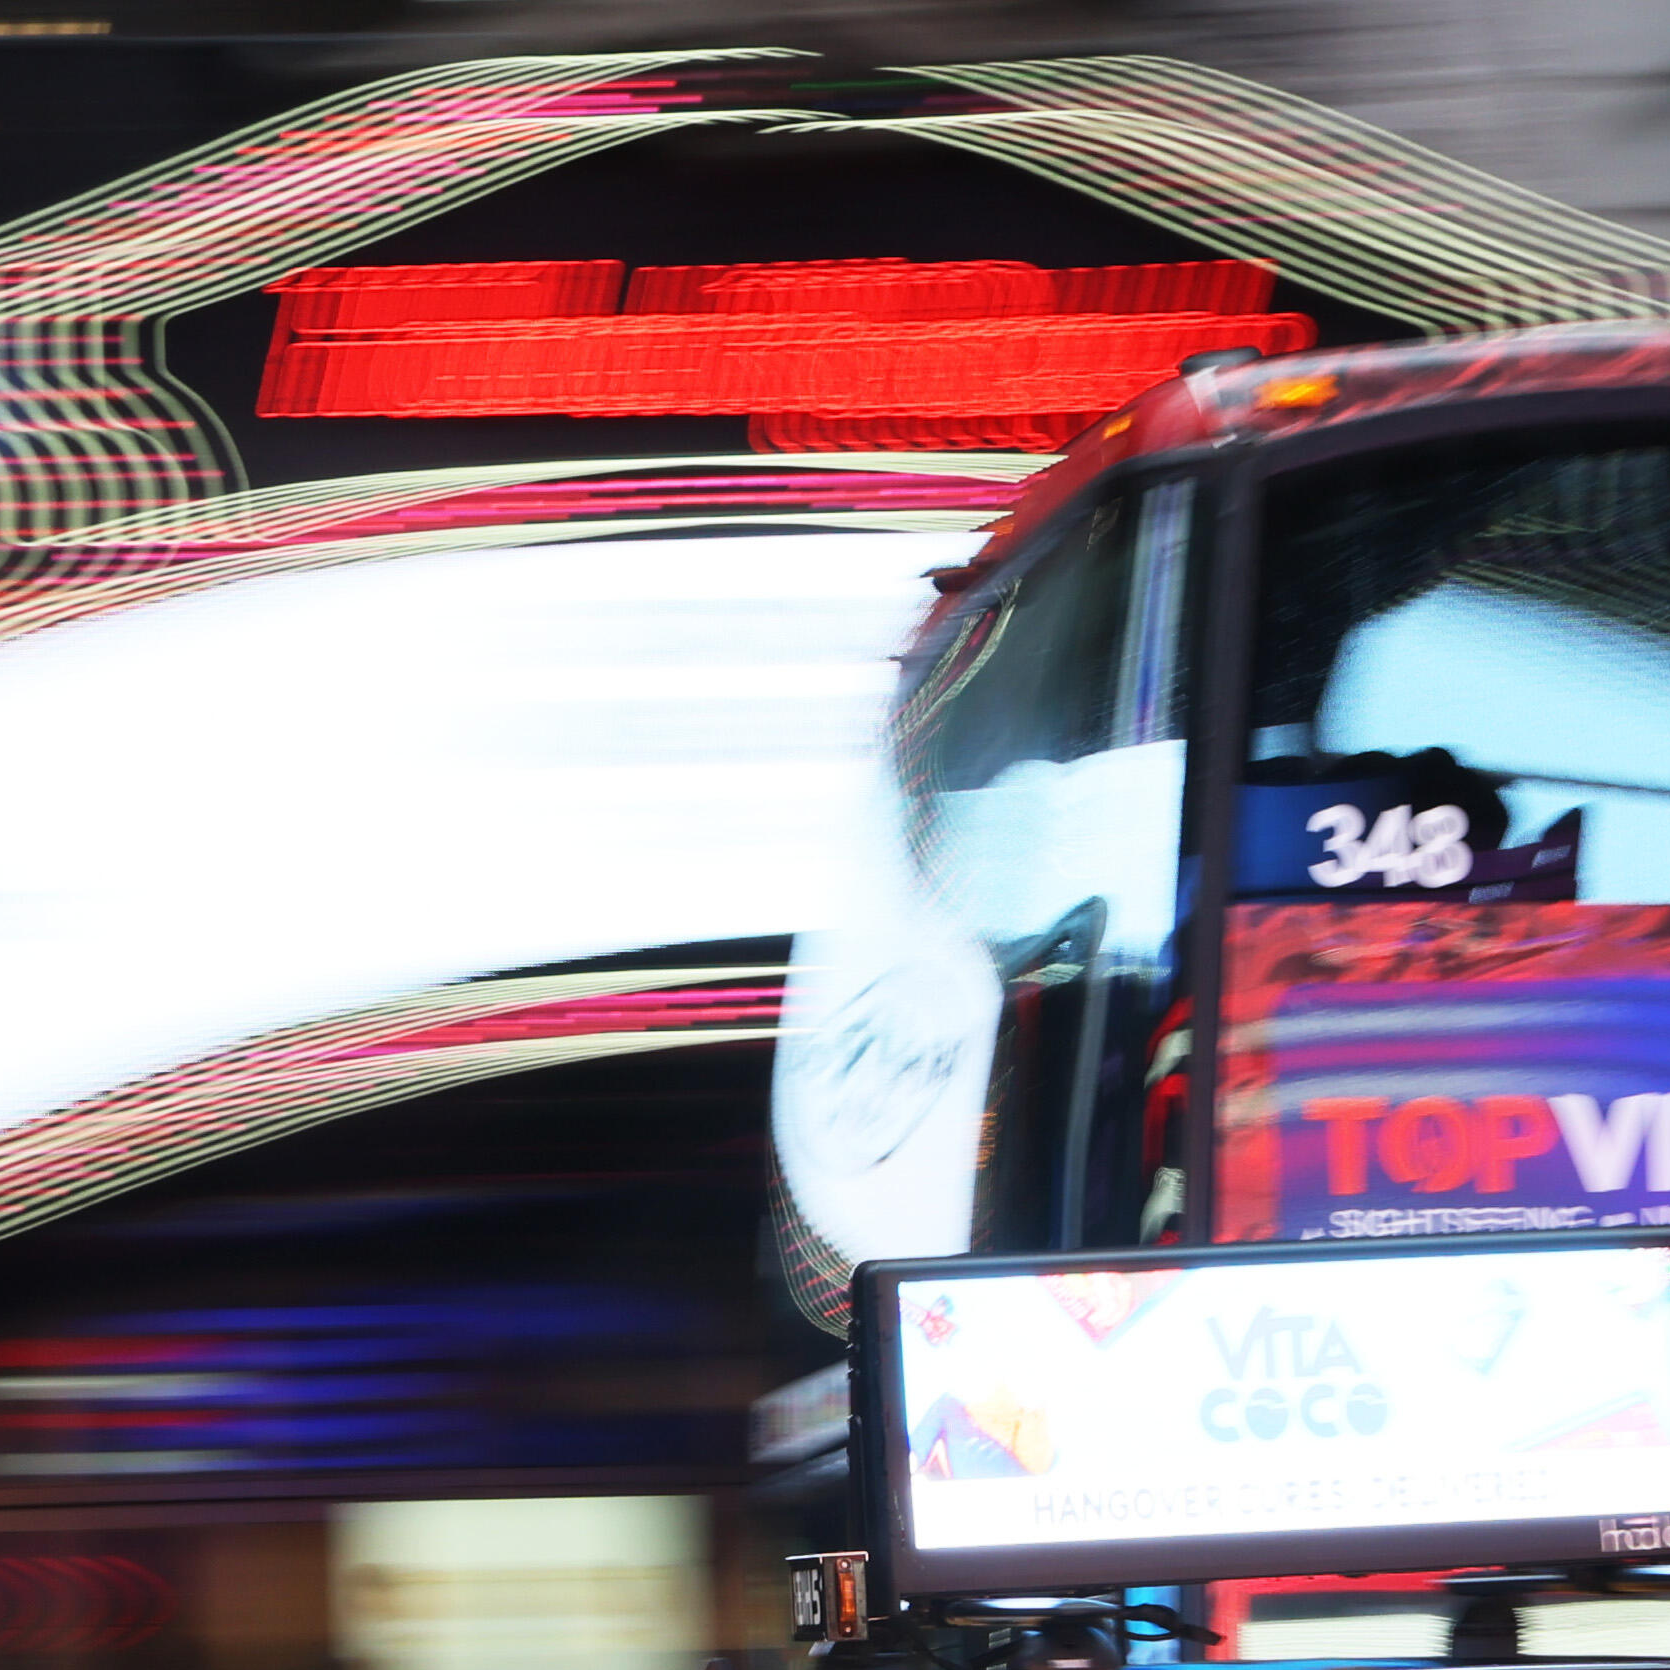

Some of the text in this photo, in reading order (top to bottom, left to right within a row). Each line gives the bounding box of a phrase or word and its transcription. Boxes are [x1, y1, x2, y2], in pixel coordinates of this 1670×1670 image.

[1307, 803, 1473, 888] 348
[1206, 1305, 1363, 1380] VITA
[1200, 1383, 1389, 1442] COCO
